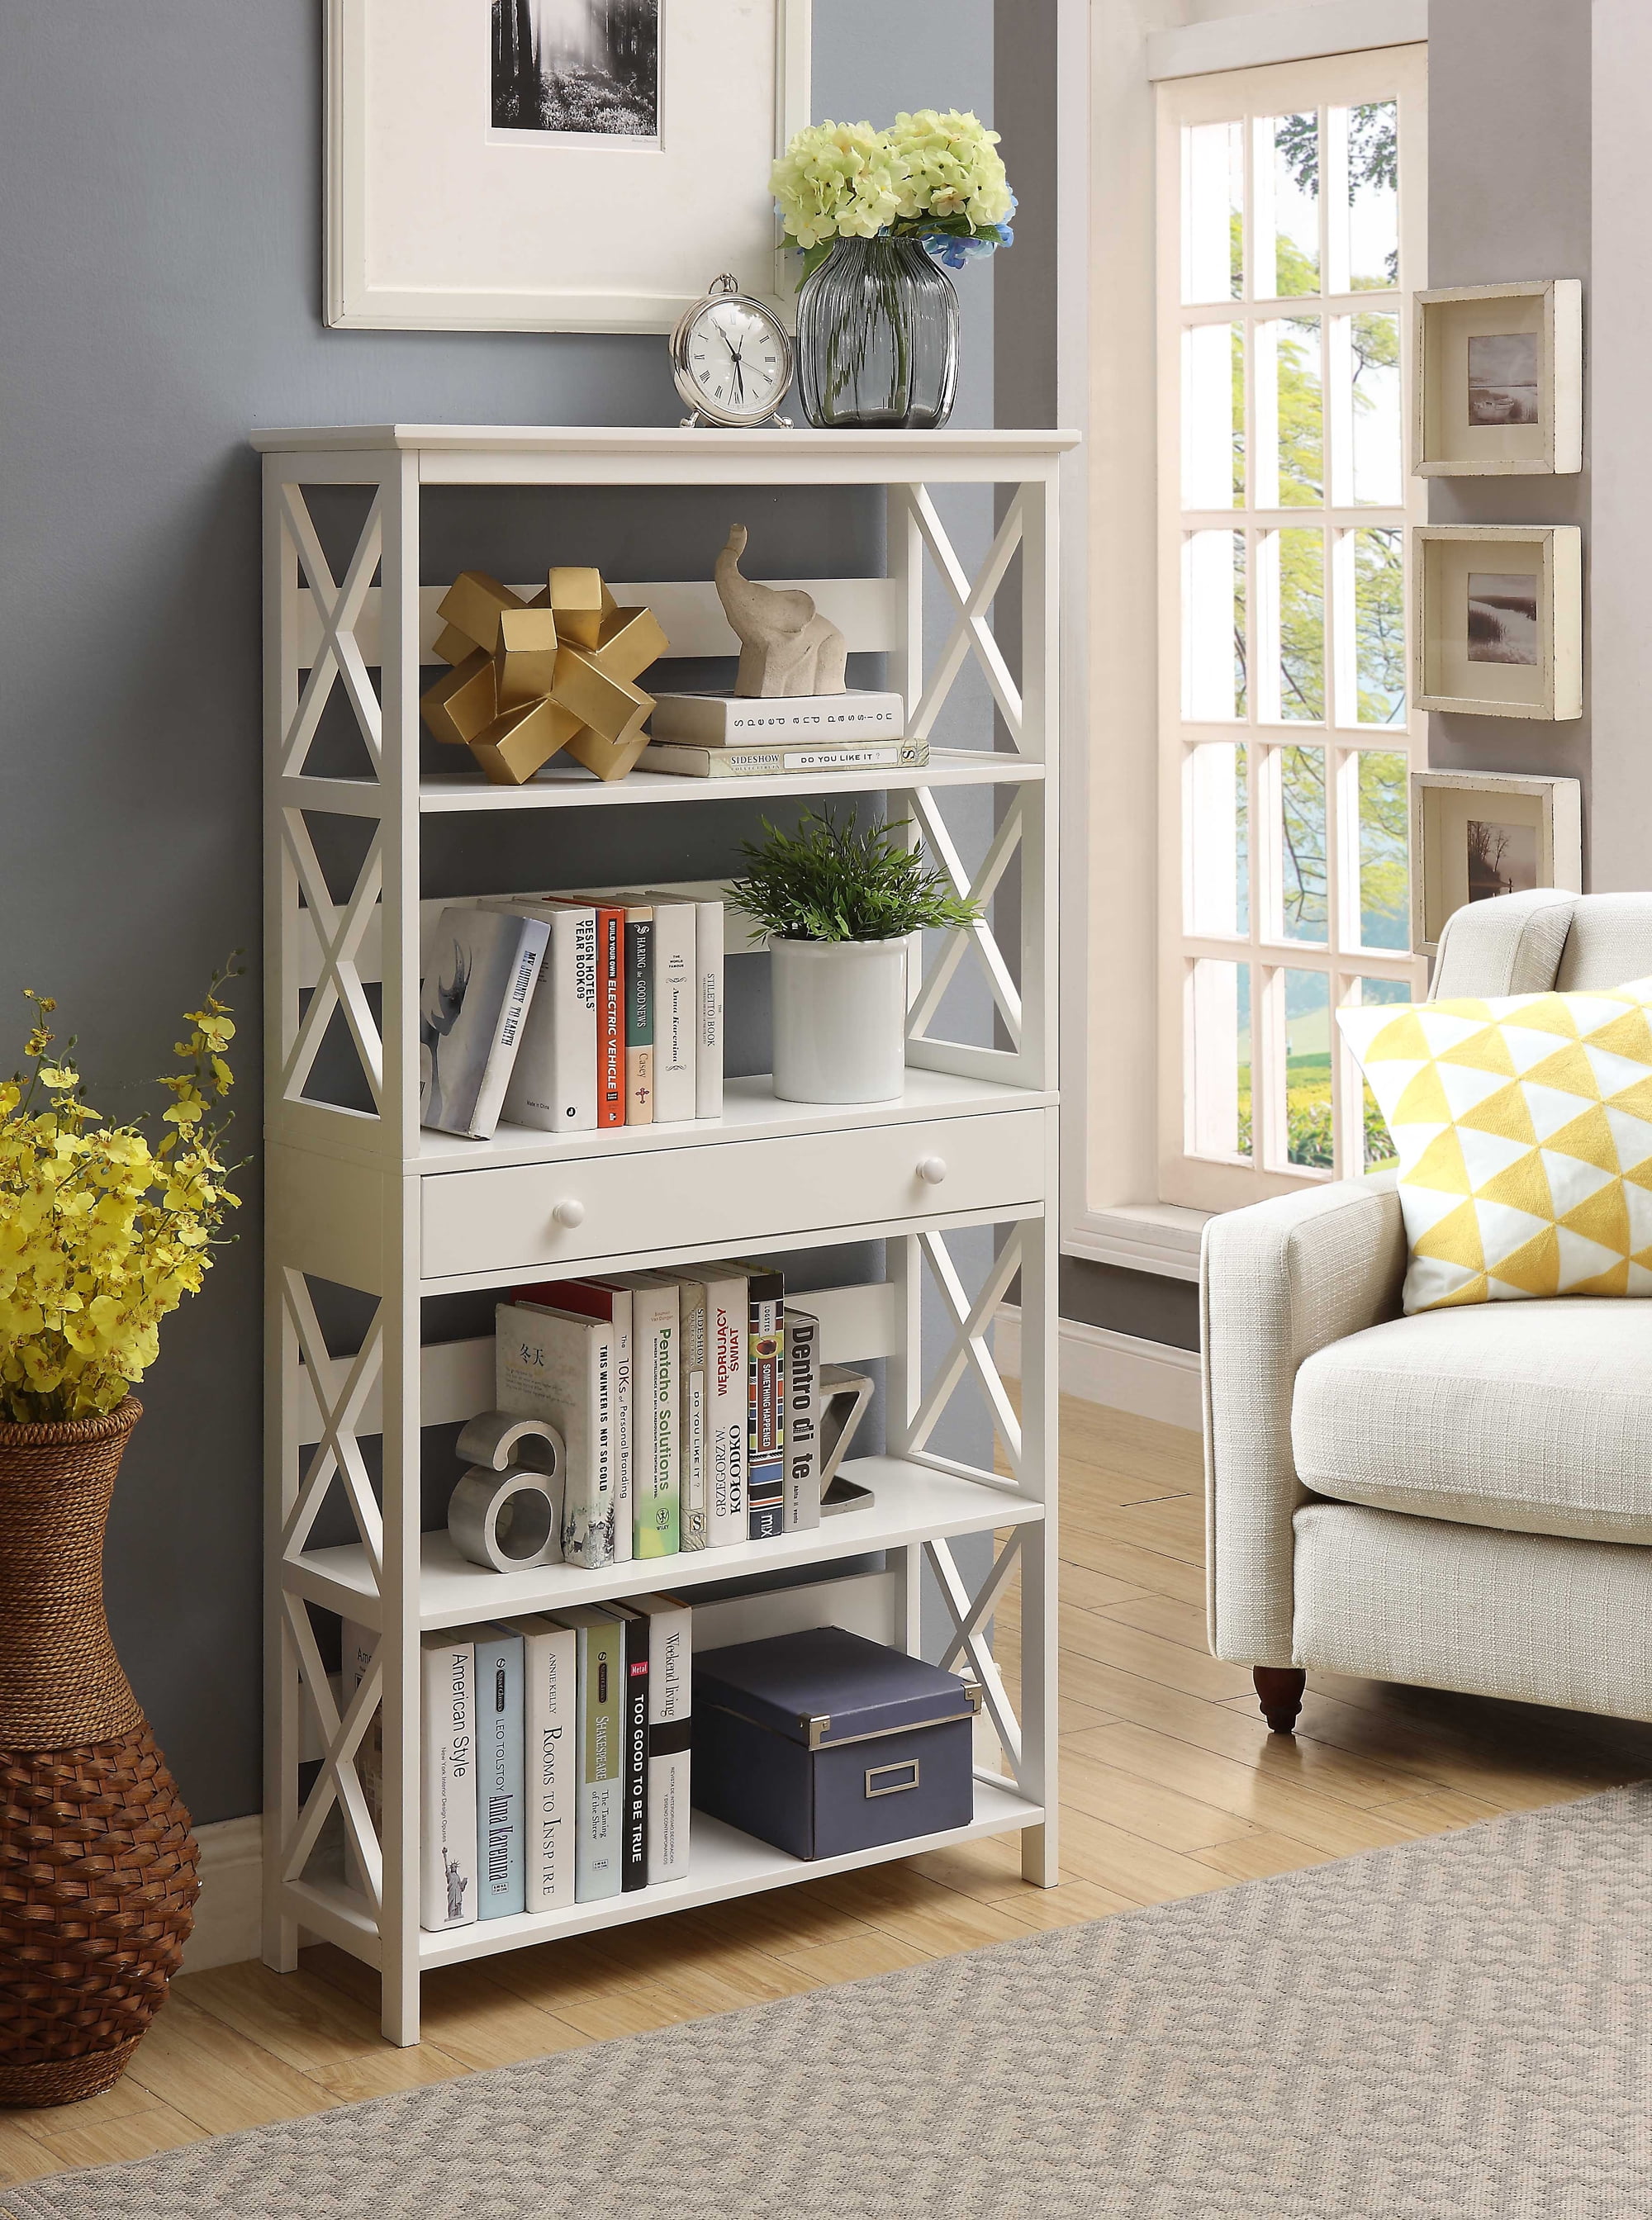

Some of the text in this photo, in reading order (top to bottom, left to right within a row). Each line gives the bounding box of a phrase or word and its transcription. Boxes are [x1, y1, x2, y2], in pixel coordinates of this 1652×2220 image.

[733, 713, 893, 727] Speed and passion
[731, 755, 780, 765] SIDESHOW
[576, 920, 585, 950] YEAR
[585, 919, 594, 961] DESIGN
[501, 951, 537, 1046] MY JOURNEY TO EARTH
[608, 980, 617, 1036] ELECTRIC
[636, 980, 647, 1003] GOOD
[637, 1004, 647, 1028] NEWS
[707, 973, 715, 1047] STILETTO BOOK
[672, 987, 680, 1063] Anna Karenina
[607, 1039, 617, 1089] VEHICLE
[637, 1053, 648, 1078] Casey
[520, 1343, 544, 1367] 冬天
[716, 1308, 729, 1397] WĘDRUJĄCY
[728, 1327, 739, 1372] ŚWIAT
[792, 1325, 814, 1411] Dentro
[599, 1345, 608, 1492] THIS WINTER IS NOT SO COLD
[659, 1328, 672, 1491] Pentaho Solutions
[694, 1392, 700, 1407] DO
[762, 1364, 771, 1447] SOMETHING HAPPENED
[620, 1405, 629, 1449] Personal
[792, 1417, 814, 1443] di
[620, 1451, 630, 1499] Branding
[694, 1468, 700, 1478] IT
[715, 1426, 726, 1517] GRZEGORZ W.
[729, 1425, 741, 1516] KOŁODKO
[792, 1453, 814, 1479] te
[548, 1653, 557, 1715] ANNIE KELLY
[632, 1663, 647, 1675] Metal
[660, 1632, 680, 1717] Weekend living
[449, 1653, 470, 1778] American Style
[496, 1719, 505, 1791] LEO TOLSTOY
[543, 1725, 563, 1786] ROOMS
[596, 1715, 610, 1781] SHAKESPEARE
[543, 1791, 555, 1813] TO
[632, 1694, 644, 1863] TOO GOOD TO BE TRUE
[488, 1794, 514, 1824] Anna
[591, 1791, 600, 1840] of the Shrew
[599, 1789, 610, 1838] The Taming
[488, 1824, 514, 1882] Karenina
